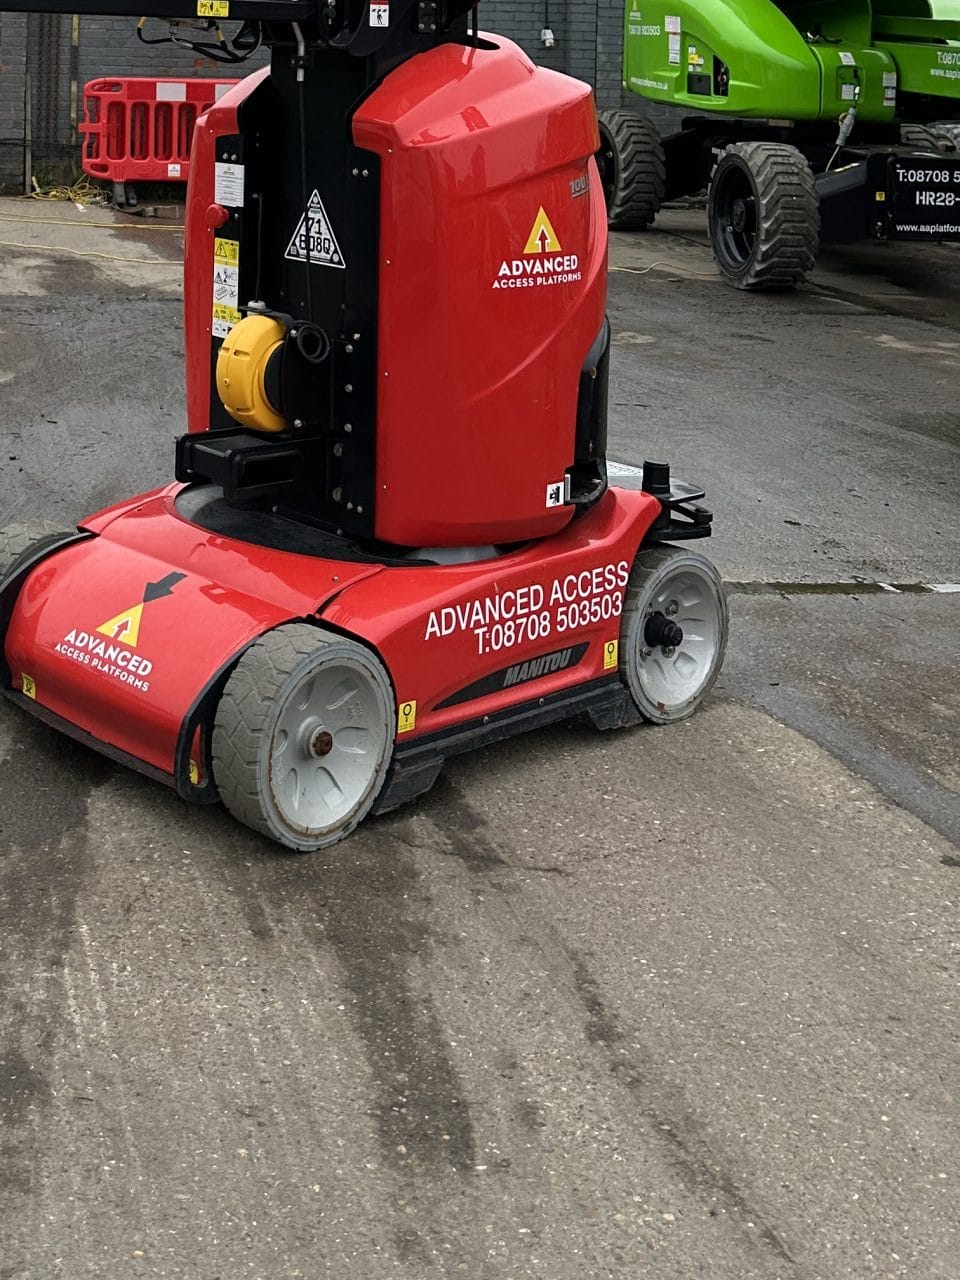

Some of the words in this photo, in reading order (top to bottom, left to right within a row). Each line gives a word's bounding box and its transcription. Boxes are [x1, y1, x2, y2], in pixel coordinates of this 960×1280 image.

[896, 169, 950, 182] T:08708
[307, 217, 323, 236] 71
[492, 278, 534, 289] ACCESS
[537, 271, 582, 286] PLATFORMS
[498, 255, 578, 277] ADVANCED
[425, 584, 544, 640] ADVANCED
[549, 561, 629, 606] ACCESS
[474, 611, 551, 655] T:08708
[556, 591, 622, 632] 503503
[54, 642, 91, 664] ACCESS
[91, 658, 150, 692] PLATFORMS
[64, 628, 153, 676] ADVANCED
[503, 648, 572, 687] MANITOU
